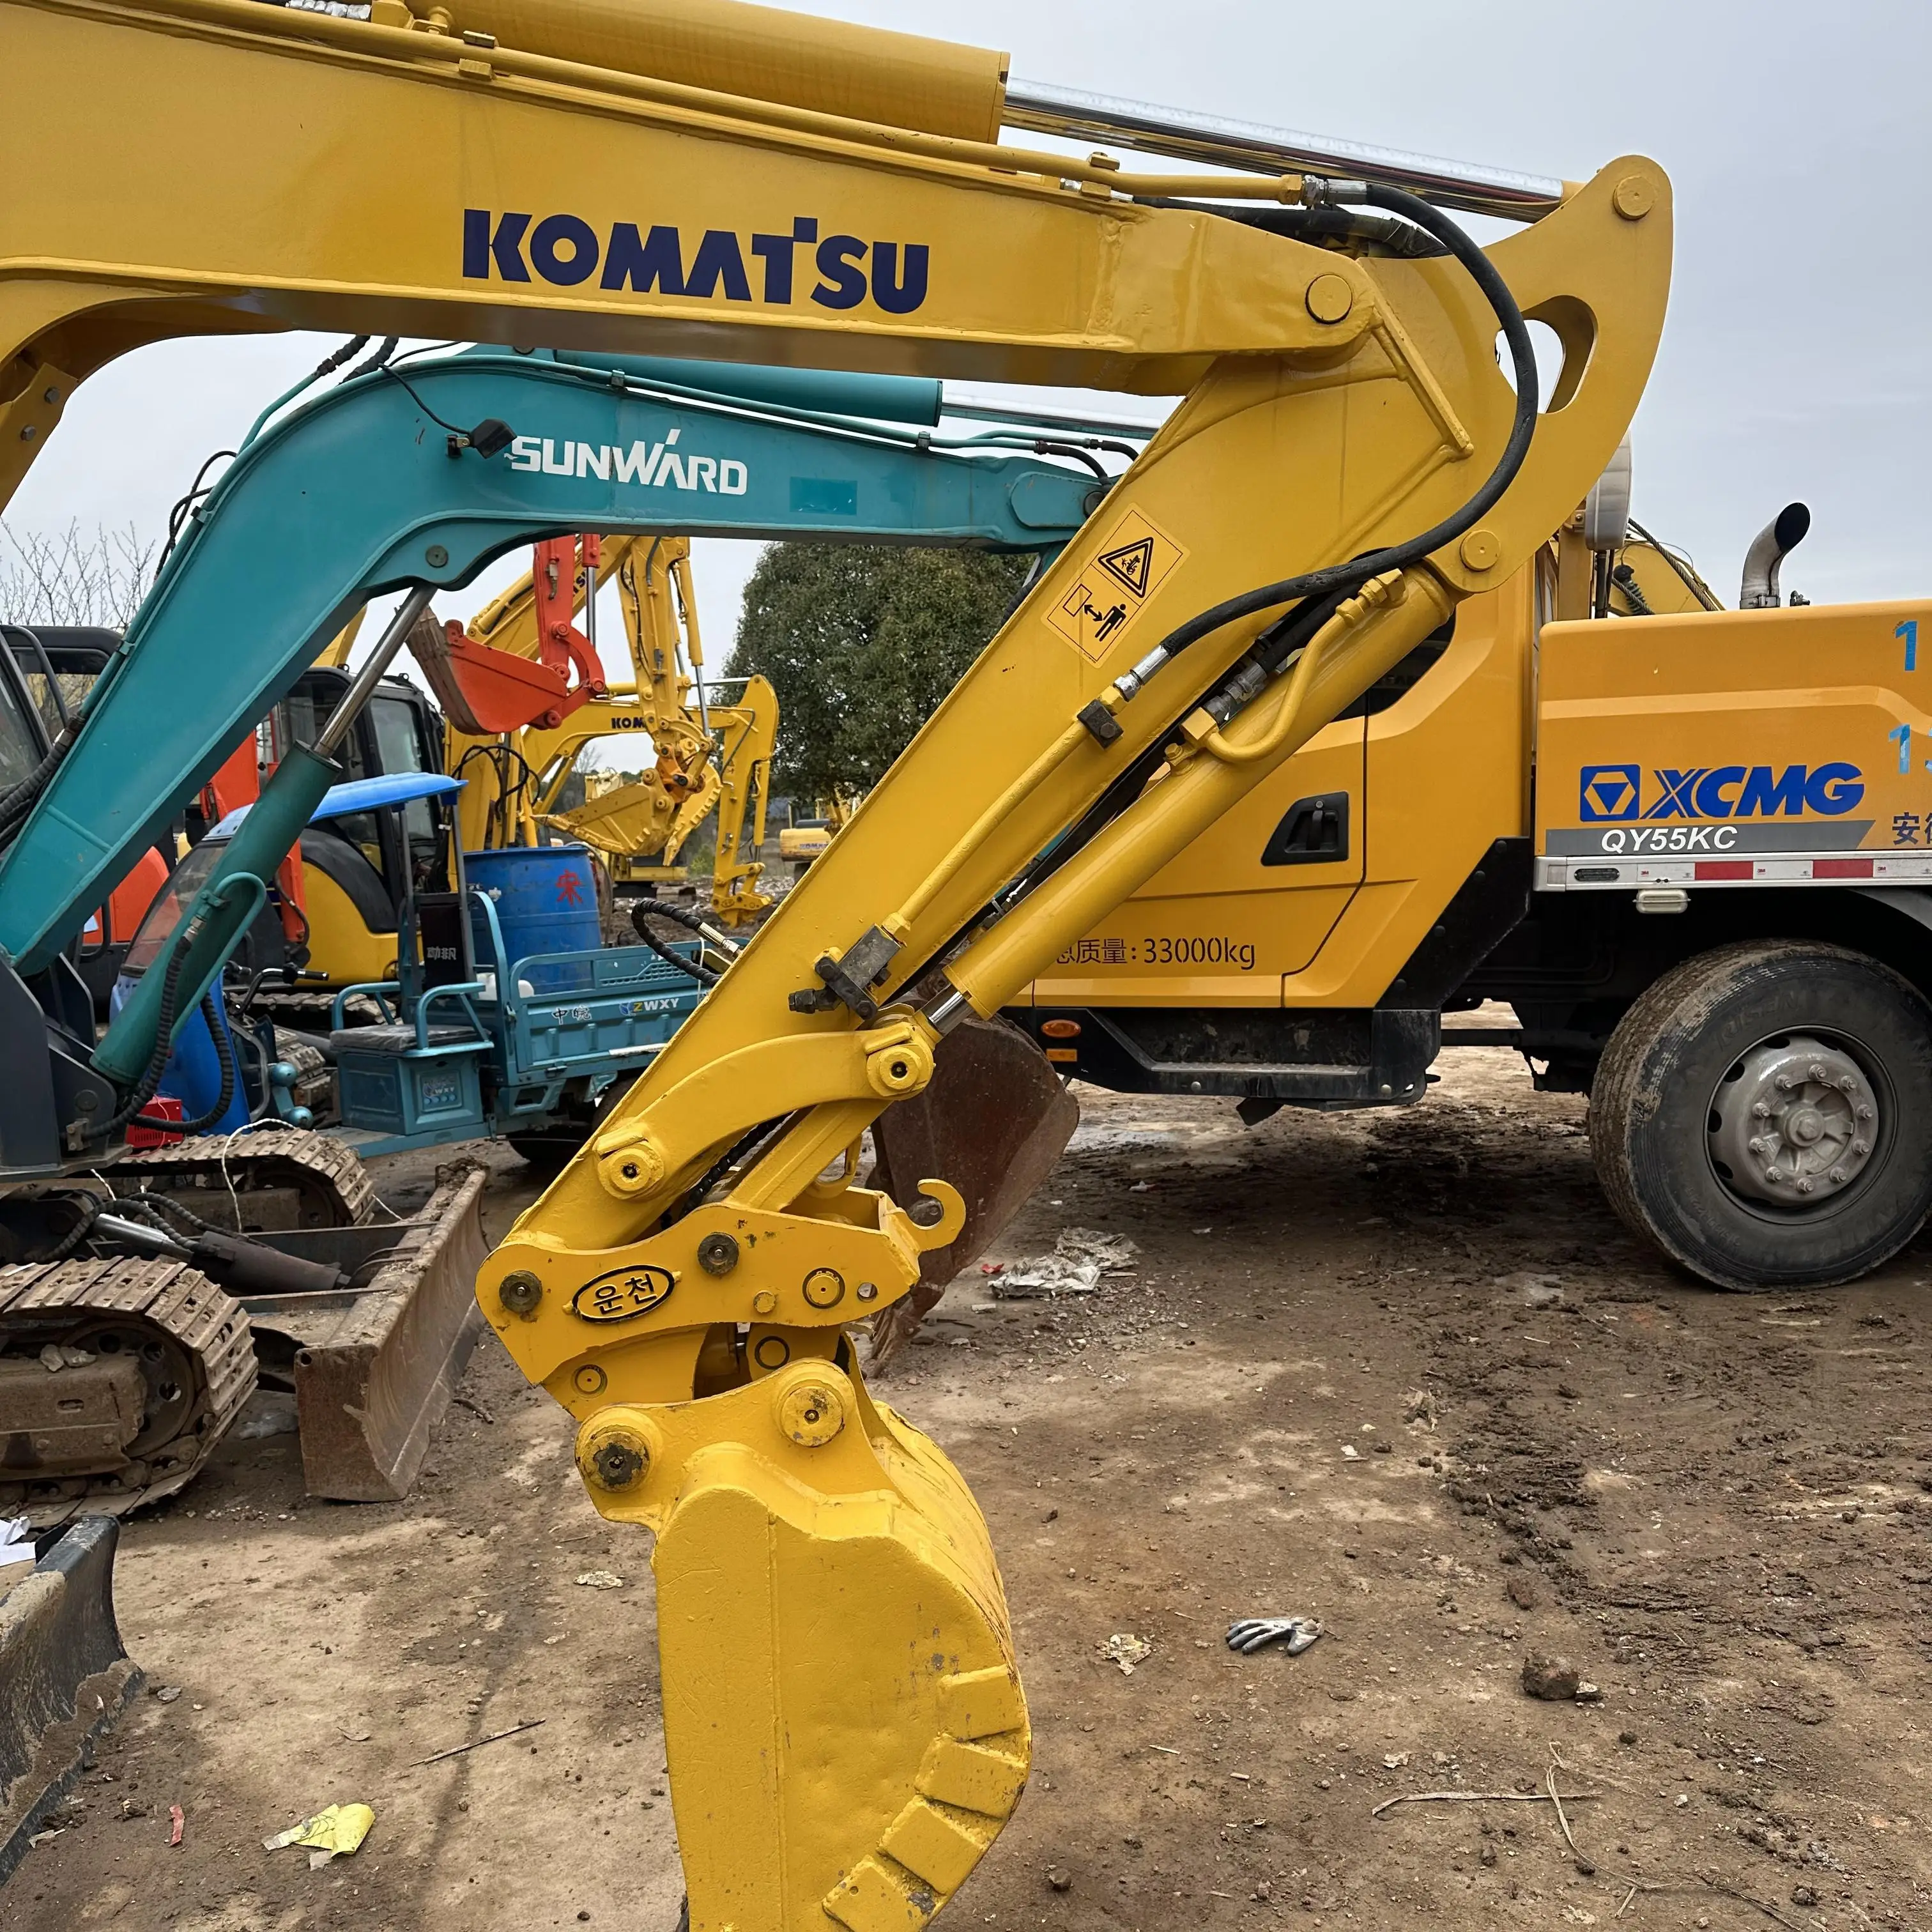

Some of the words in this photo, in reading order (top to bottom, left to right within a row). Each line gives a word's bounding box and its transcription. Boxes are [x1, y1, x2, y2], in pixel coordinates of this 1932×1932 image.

[463, 209, 929, 314] KOMATSU
[512, 429, 747, 496] SUNWARD
[1889, 724, 1932, 774] 1
[1639, 762, 1865, 819] XCMG
[1601, 826, 1737, 854] QY55KC
[634, 998, 679, 1012] ZWXY
[593, 1272, 657, 1314] 운천
